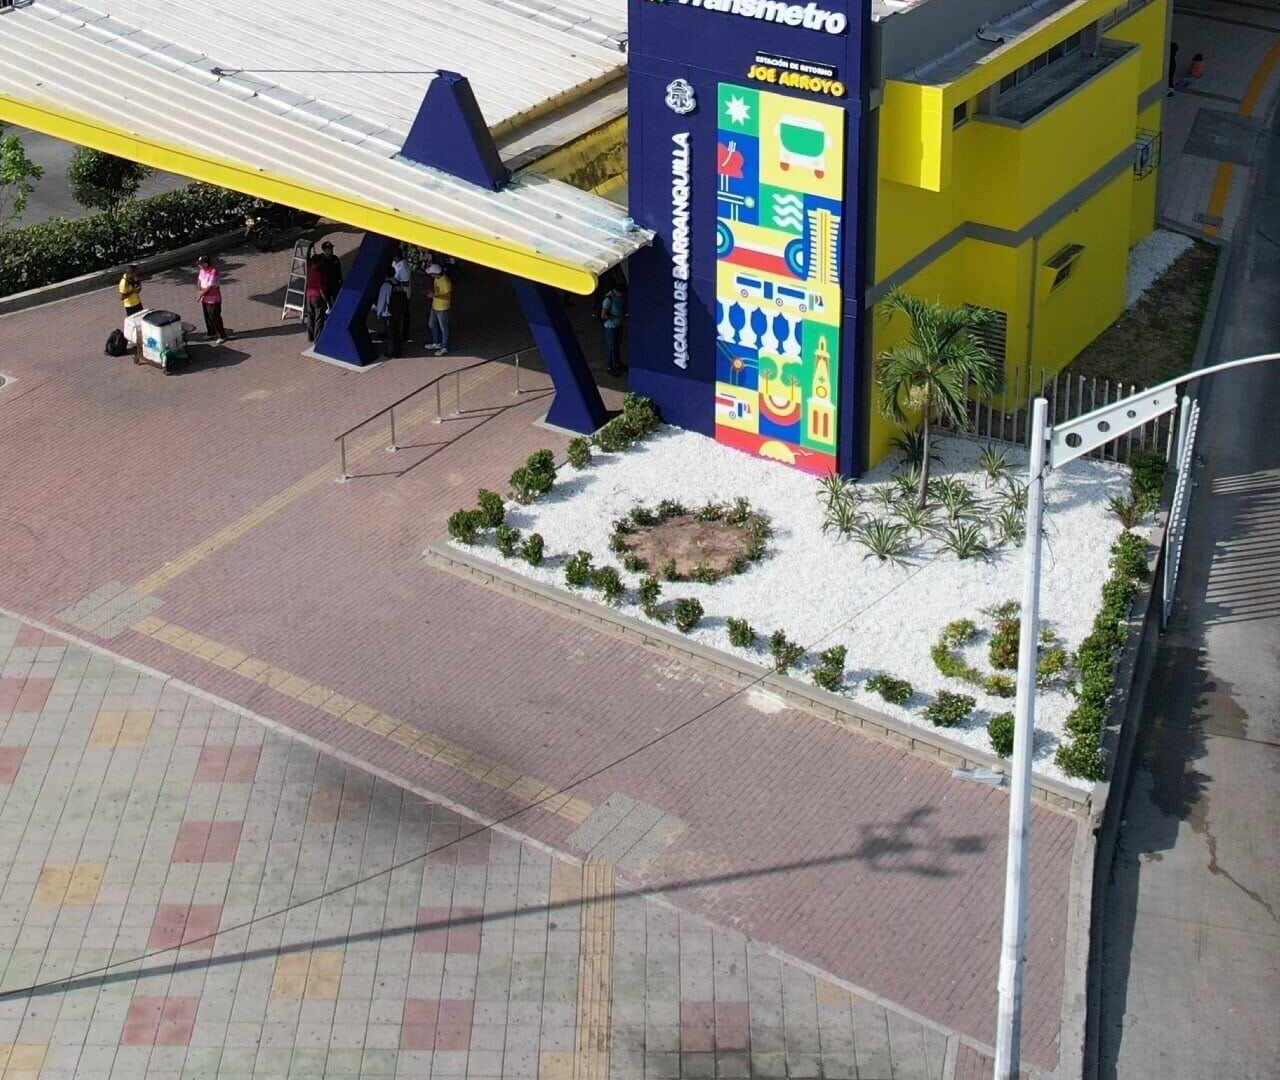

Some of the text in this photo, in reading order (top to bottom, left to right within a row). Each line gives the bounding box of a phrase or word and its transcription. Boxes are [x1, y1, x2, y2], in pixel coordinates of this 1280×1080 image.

[789, 62, 799, 70] DE
[747, 64, 845, 97] JOE ARROYO
[671, 132, 690, 281] BARRANQUILLA
[673, 280, 688, 301] DE
